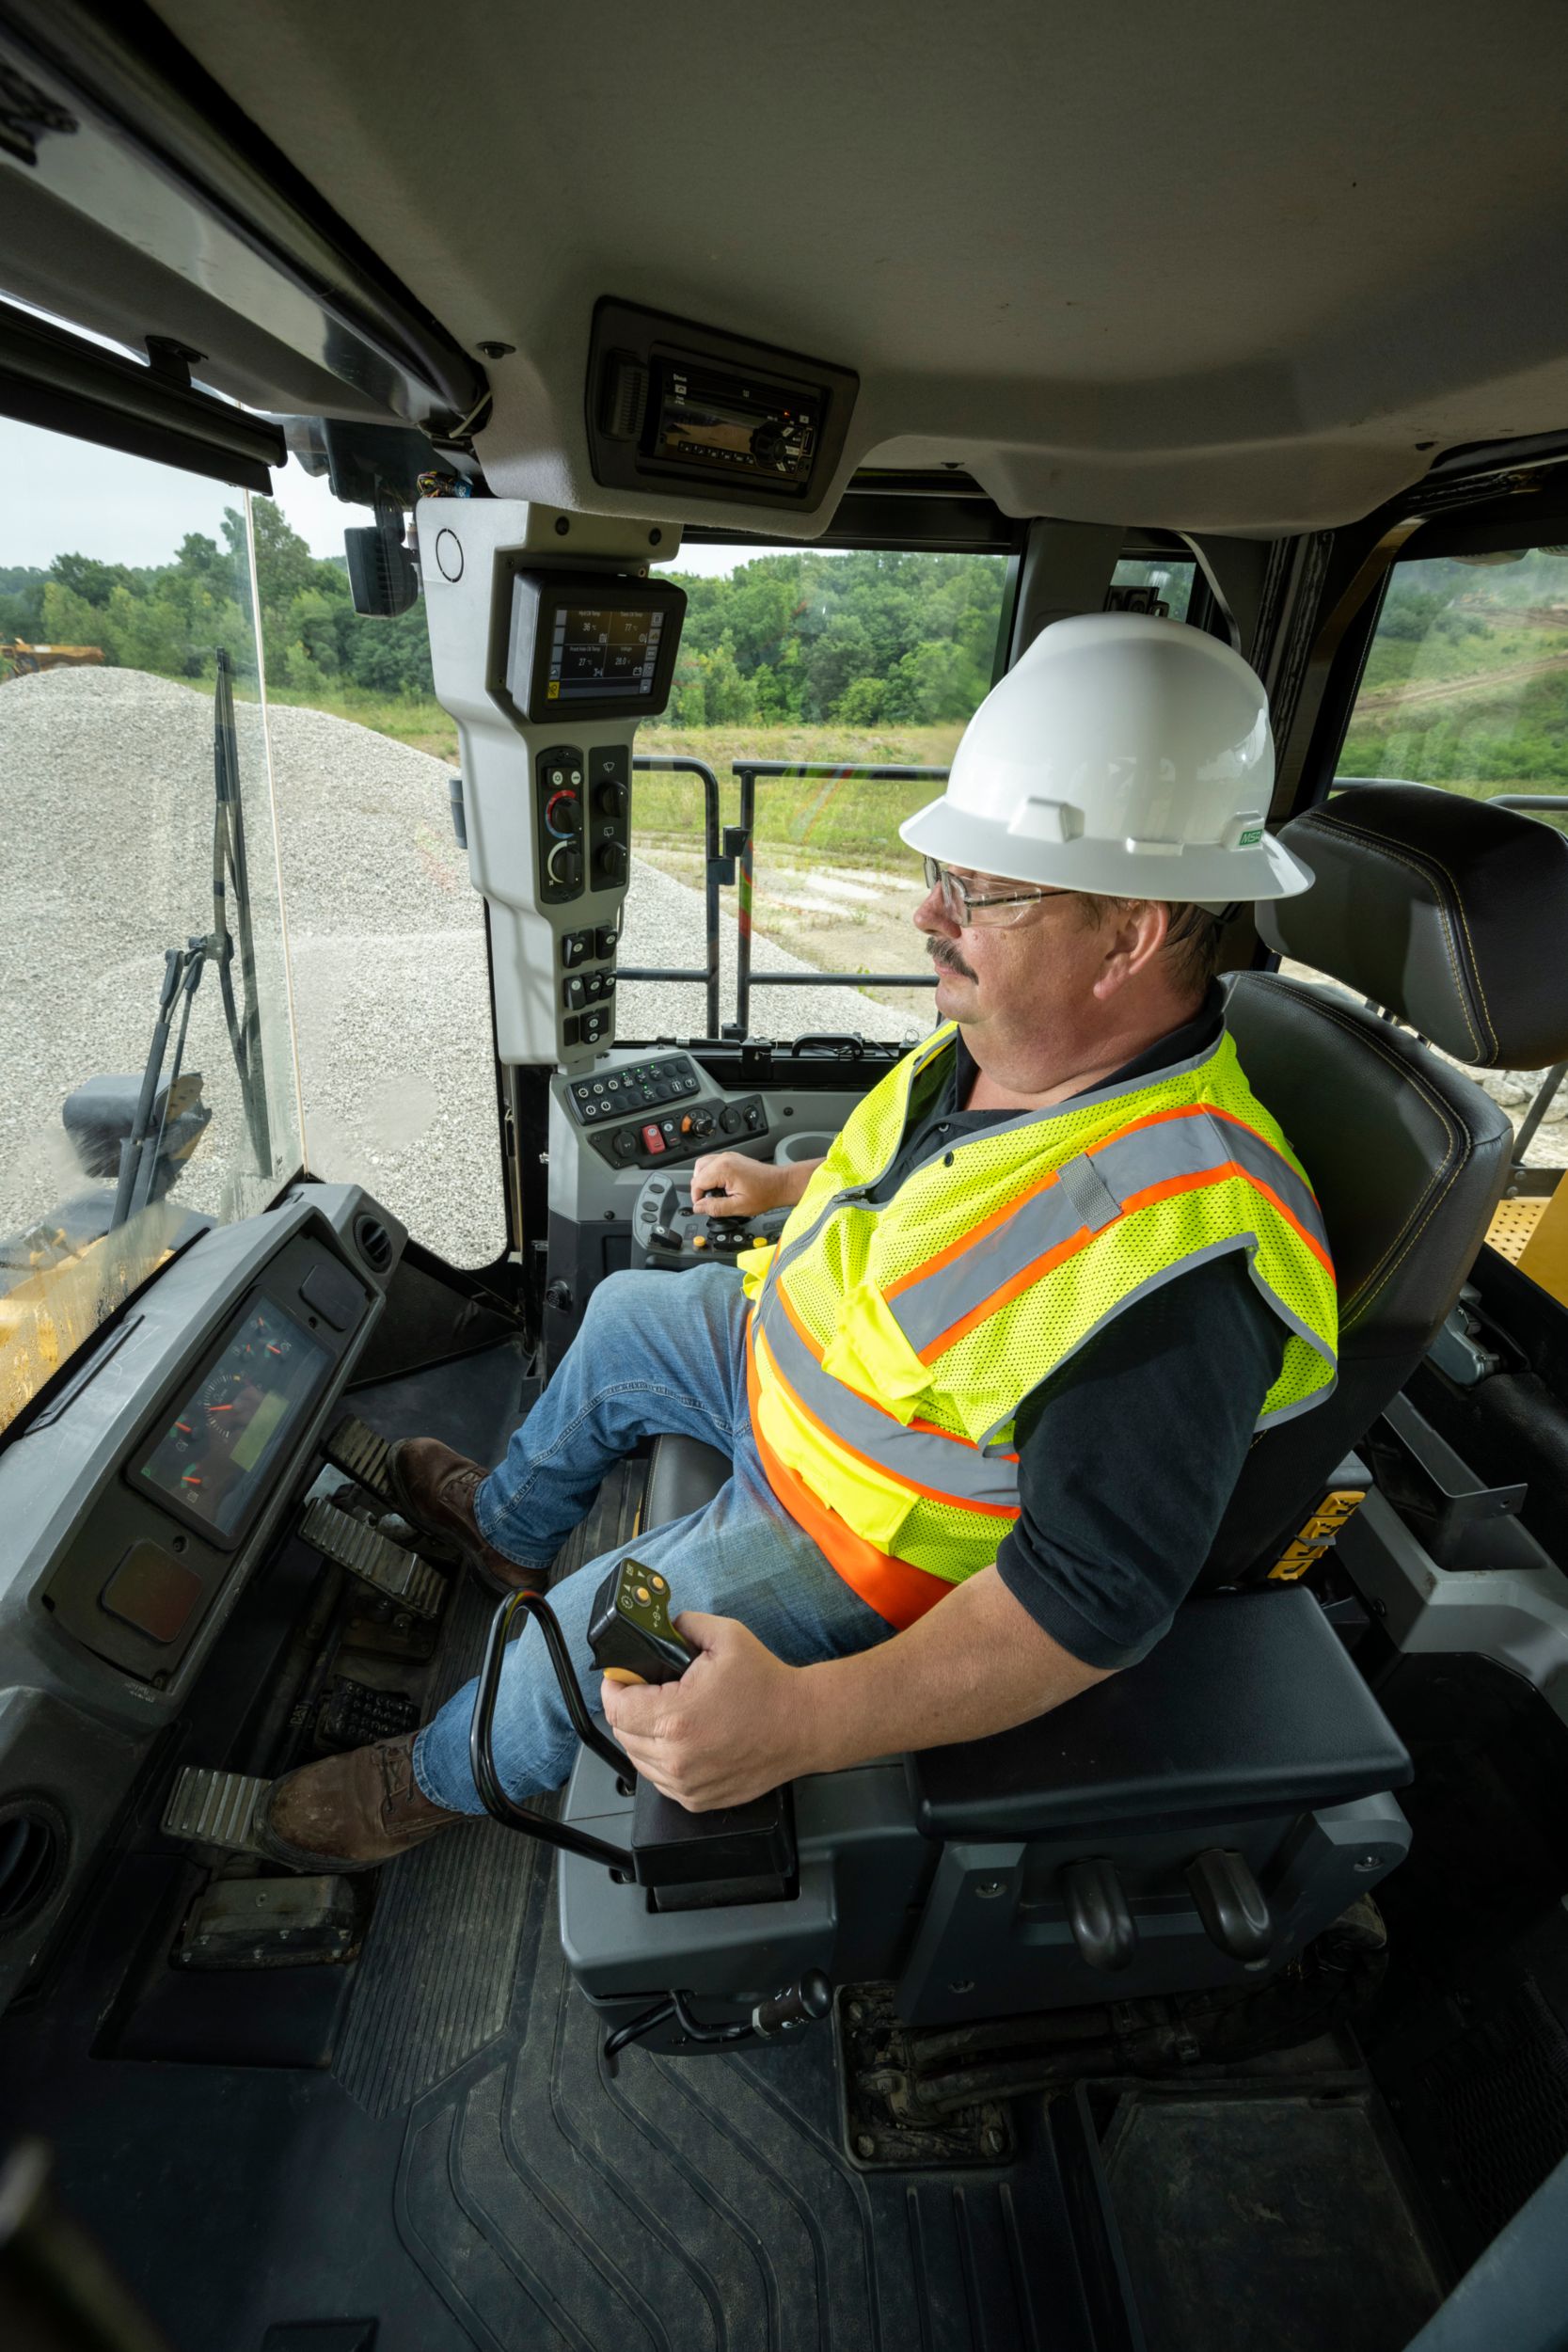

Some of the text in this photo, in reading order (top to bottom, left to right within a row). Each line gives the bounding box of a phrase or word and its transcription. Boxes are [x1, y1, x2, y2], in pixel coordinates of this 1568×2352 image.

[583, 622, 591, 631] 36
[625, 623, 632, 632] 77
[1241, 831, 1260, 843] MSA
